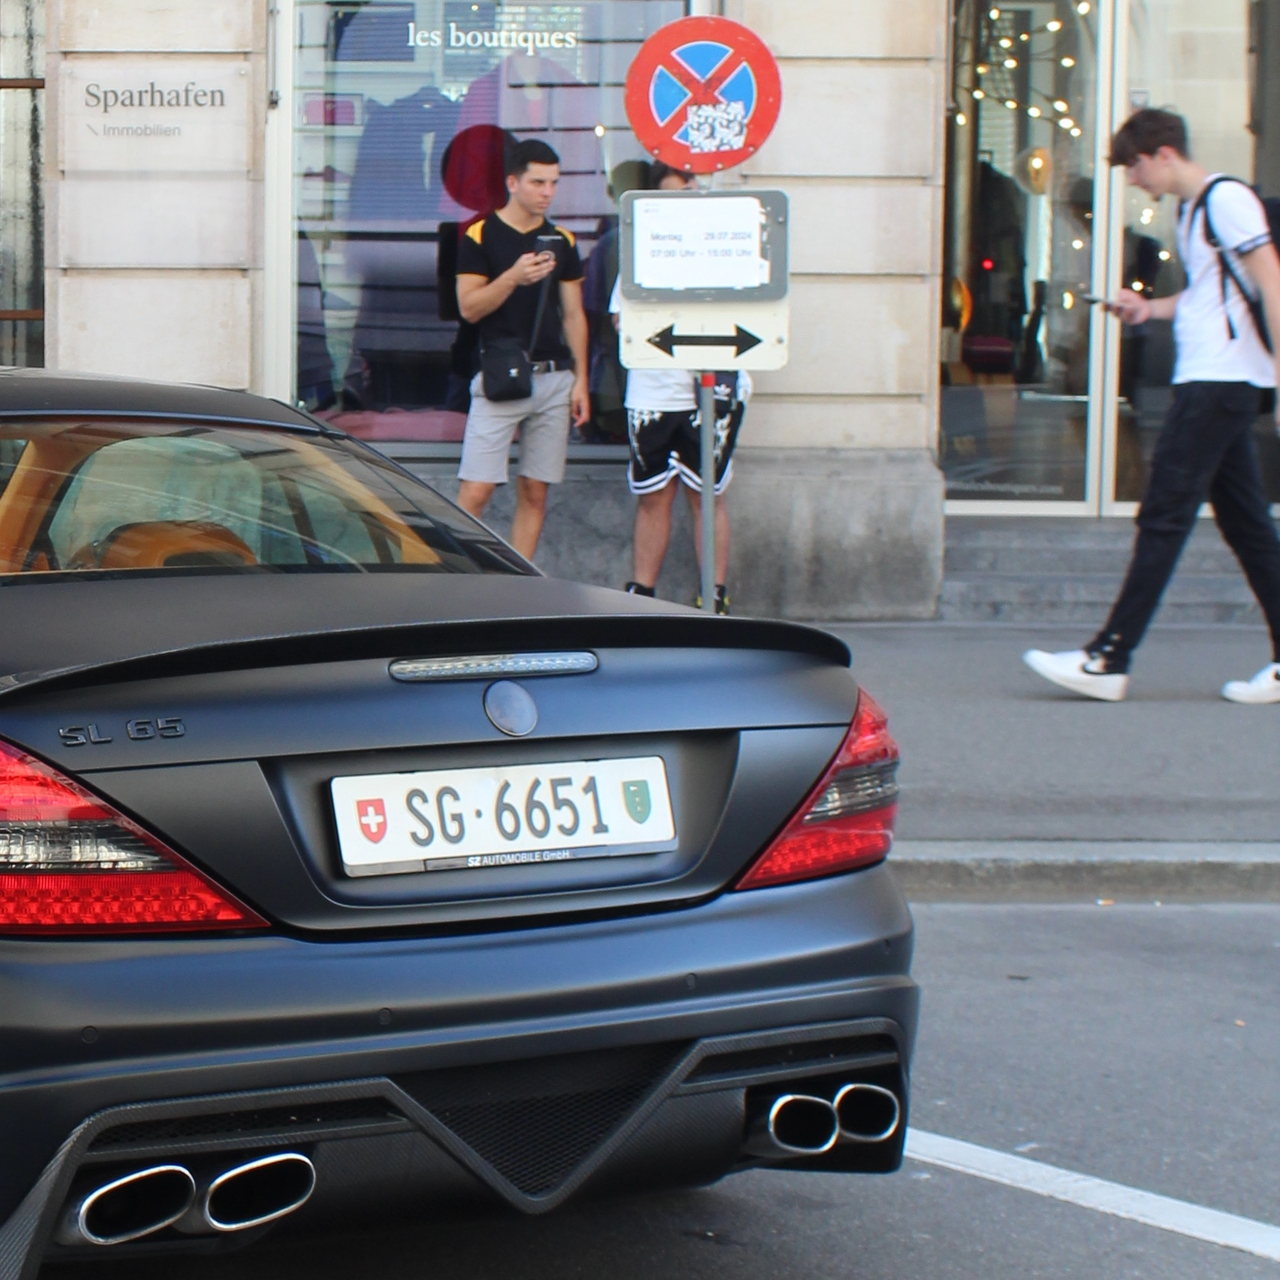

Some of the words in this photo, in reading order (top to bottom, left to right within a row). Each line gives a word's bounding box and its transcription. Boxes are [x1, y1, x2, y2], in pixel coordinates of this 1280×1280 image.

[407, 22, 442, 48] les
[449, 22, 578, 56] boutiques
[84, 81, 226, 114] Sparhafen
[102, 123, 182, 137] Immobilien
[650, 232, 683, 242] Montag
[58, 723, 113, 747] SL
[126, 717, 186, 741] 65
[467, 856, 481, 868] SZ
[482, 851, 541, 865] AUTOMOBILE
[542, 850, 570, 860] GmbH
